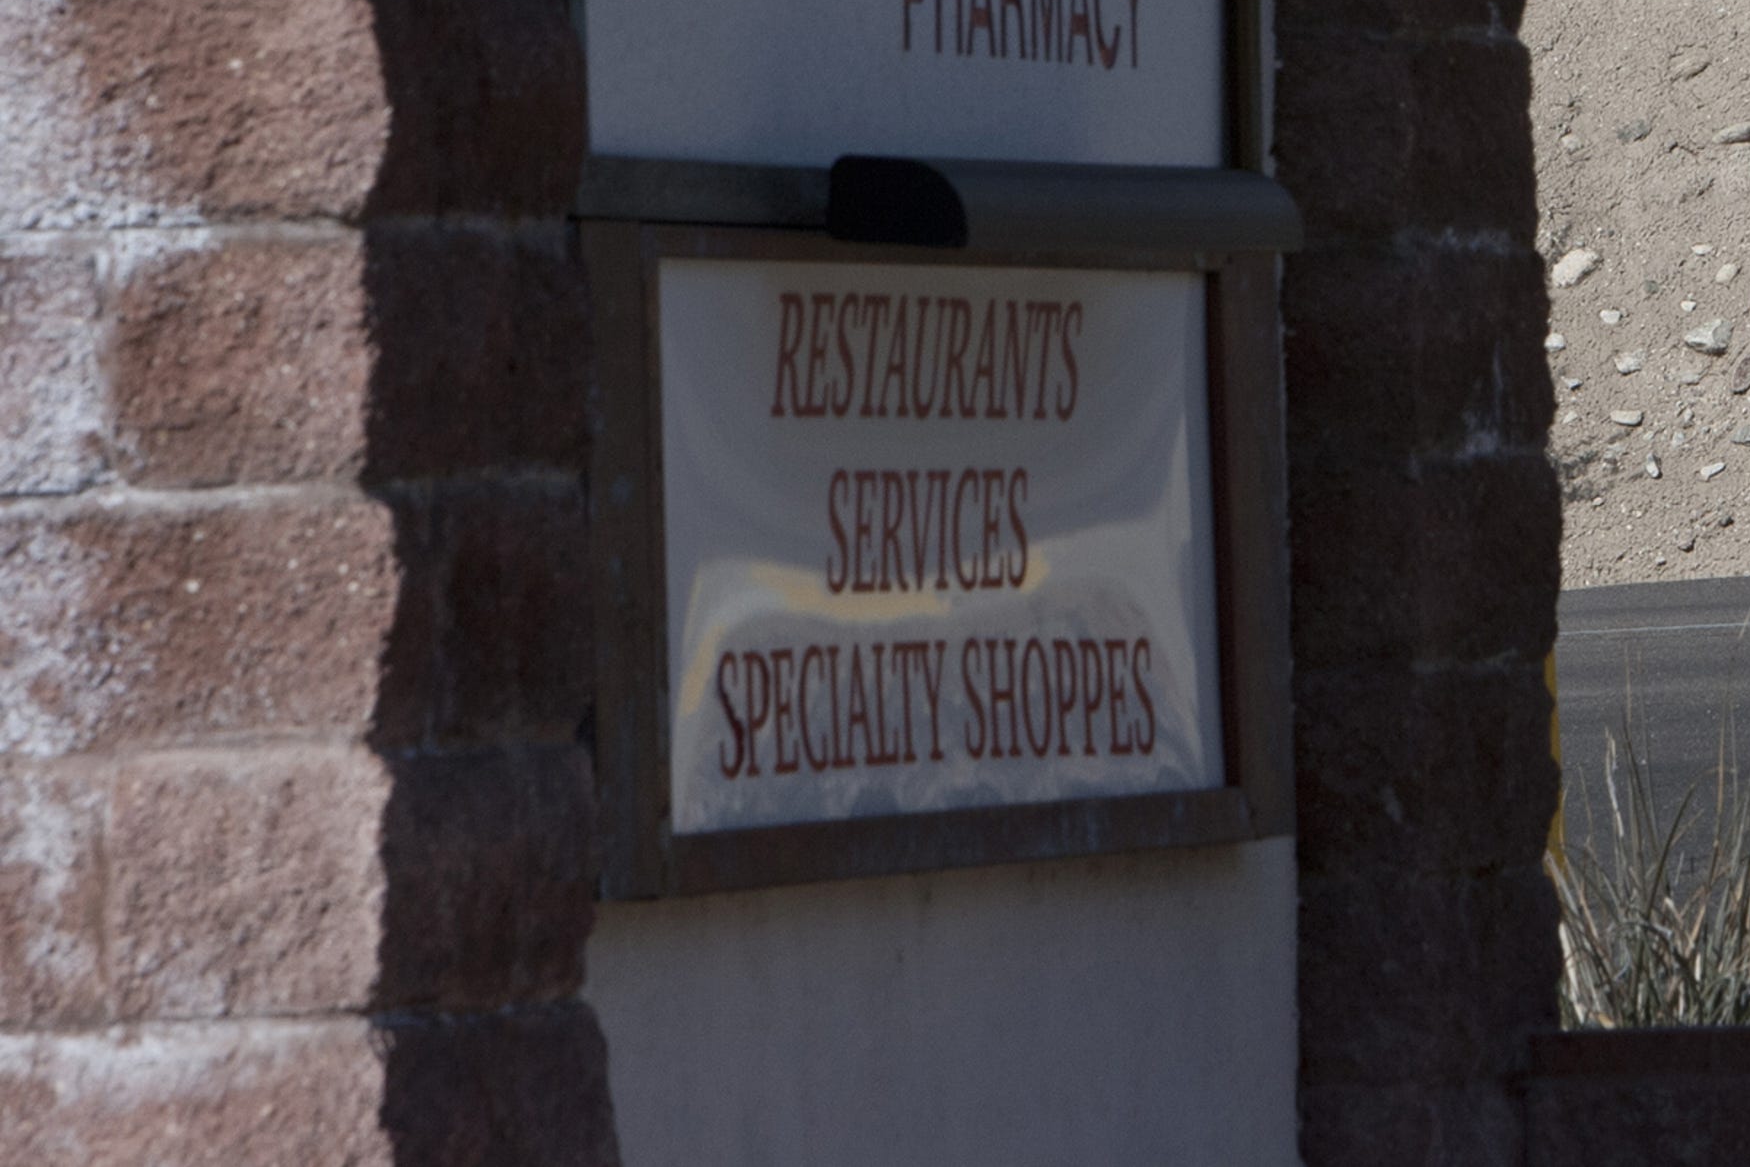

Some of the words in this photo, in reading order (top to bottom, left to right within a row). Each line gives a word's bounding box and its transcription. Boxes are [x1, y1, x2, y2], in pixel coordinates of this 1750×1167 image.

[770, 291, 1083, 422] RESTAURANTS
[826, 467, 1029, 594] SERVICES
[716, 639, 947, 780] SPECIALTY
[960, 637, 1157, 761] SHOPPES
